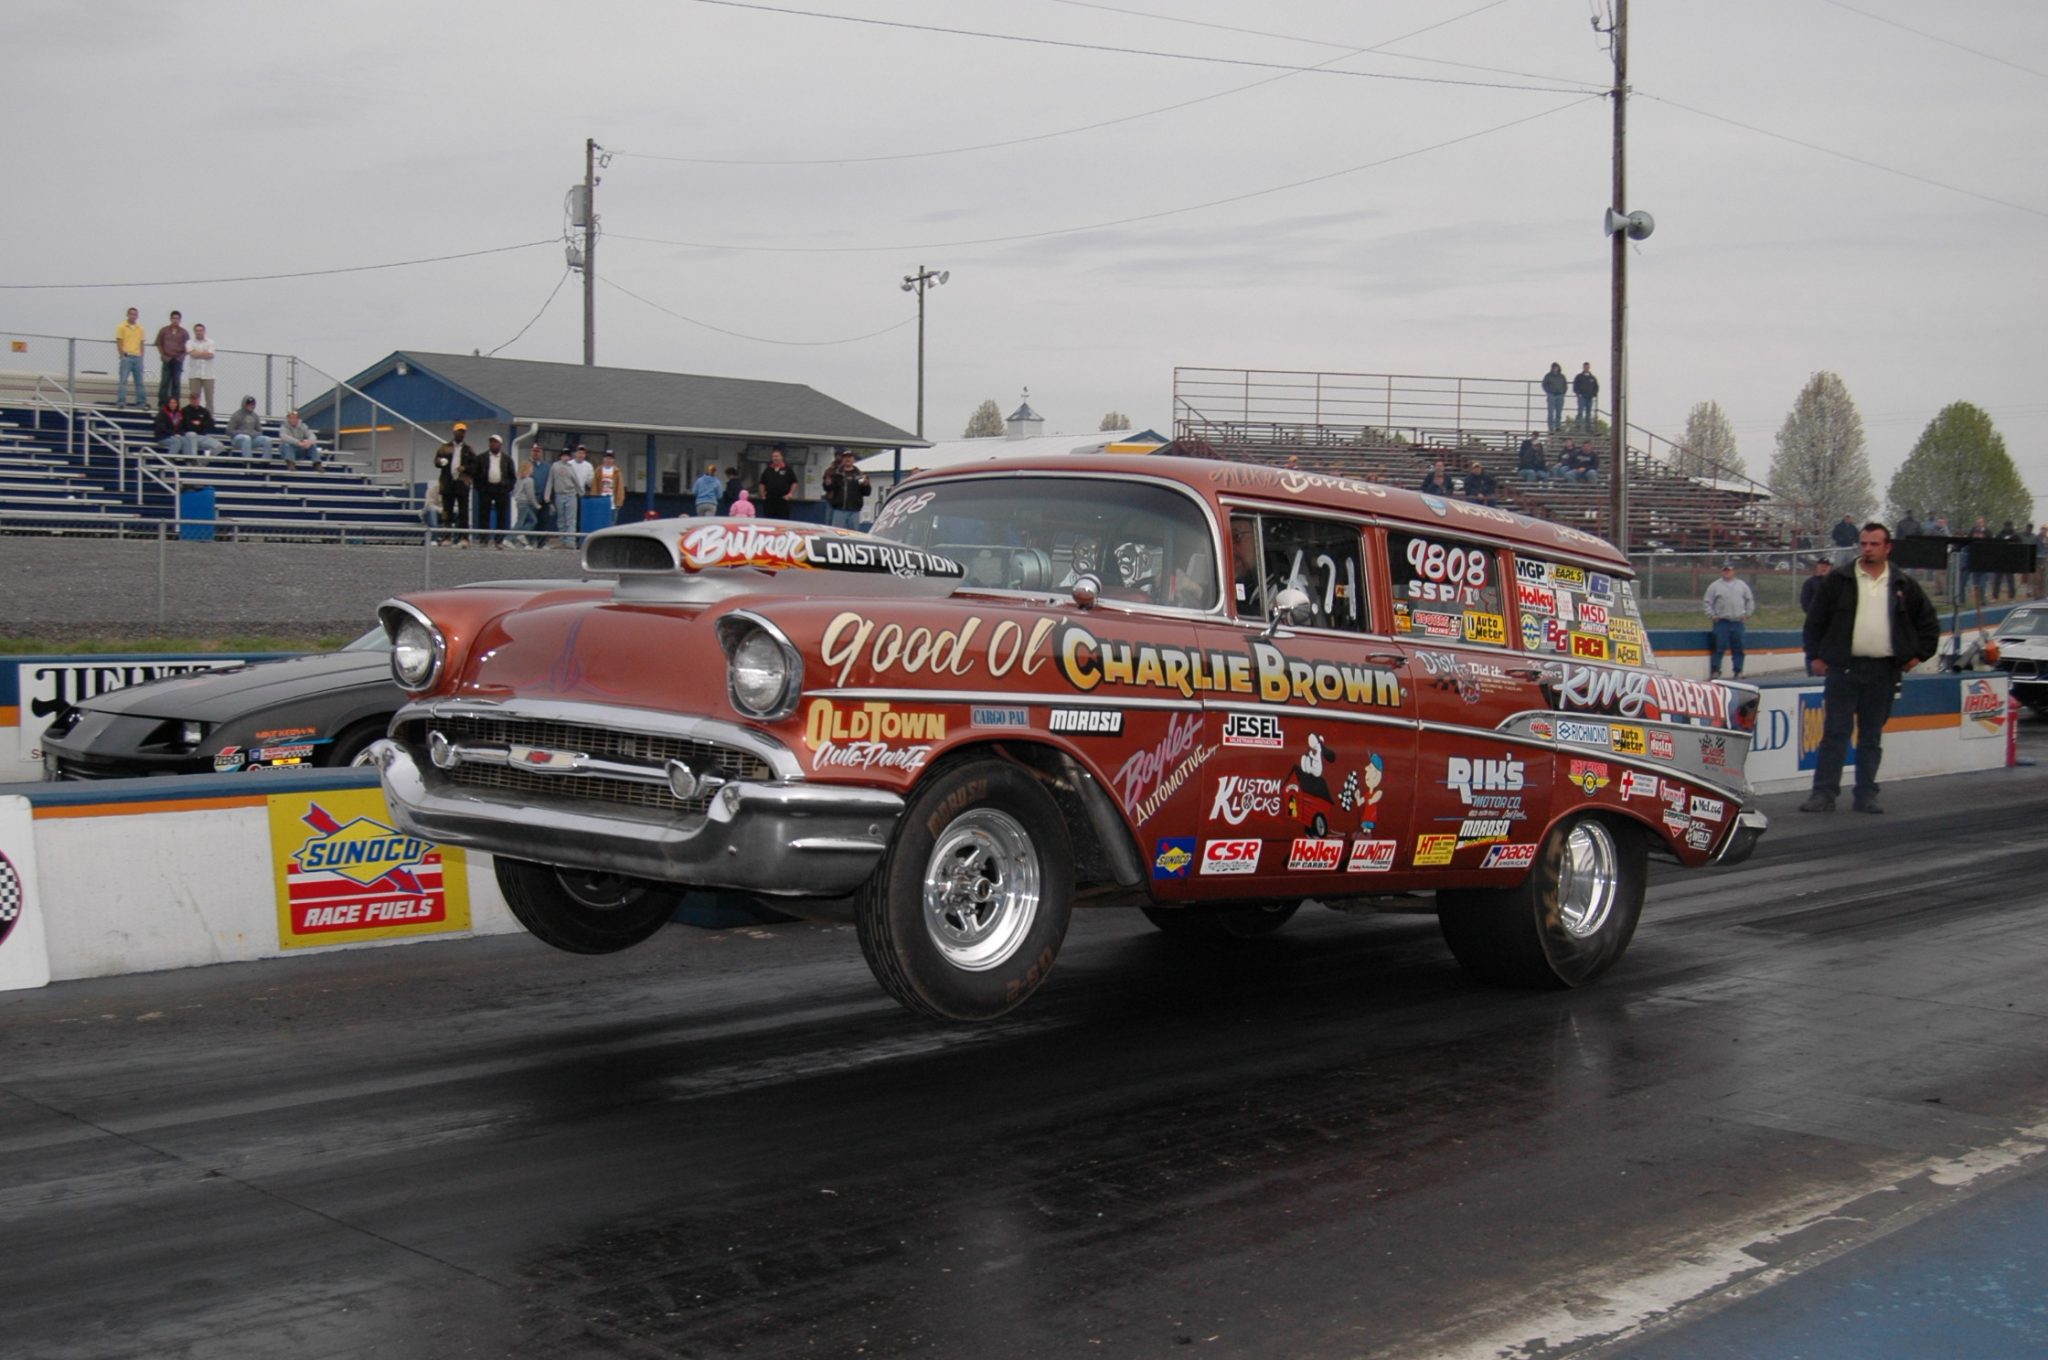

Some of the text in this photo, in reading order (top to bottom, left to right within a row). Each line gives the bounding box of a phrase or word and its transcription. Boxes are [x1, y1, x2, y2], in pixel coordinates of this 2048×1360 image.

[804, 534, 960, 578] CONSTRUCTION
[1407, 538, 1487, 588] 9808
[1516, 560, 1545, 580] MGP
[1517, 585, 1554, 615] Holley
[1476, 615, 1499, 627] Auto
[1580, 603, 1606, 624] MSD
[1476, 627, 1503, 640] Meter
[1062, 626, 1253, 699] CHARLIE
[1253, 641, 1401, 708] BROWN
[1545, 663, 1657, 717] King
[1651, 675, 1728, 718] LIBERTY
[973, 709, 1027, 726] CARGO PAL
[1050, 709, 1122, 732] MOROSO
[1225, 716, 1281, 739] JESEL
[1571, 724, 1608, 743] RICHMOND
[1620, 728, 1639, 740] Auto
[1620, 739, 1644, 752] Meter
[1447, 752, 1525, 804] RIK'S
[1472, 795, 1507, 809] MOTOR
[1459, 819, 1511, 837] MOROSO
[306, 838, 421, 867] SUNOCO
[1157, 852, 1191, 867] SUNOCO
[1206, 841, 1259, 861] CSR
[1292, 839, 1341, 868] Holley
[1496, 844, 1535, 864] pace
[1301, 861, 1329, 869] CARBS
[303, 898, 434, 927] RACE FUELS
